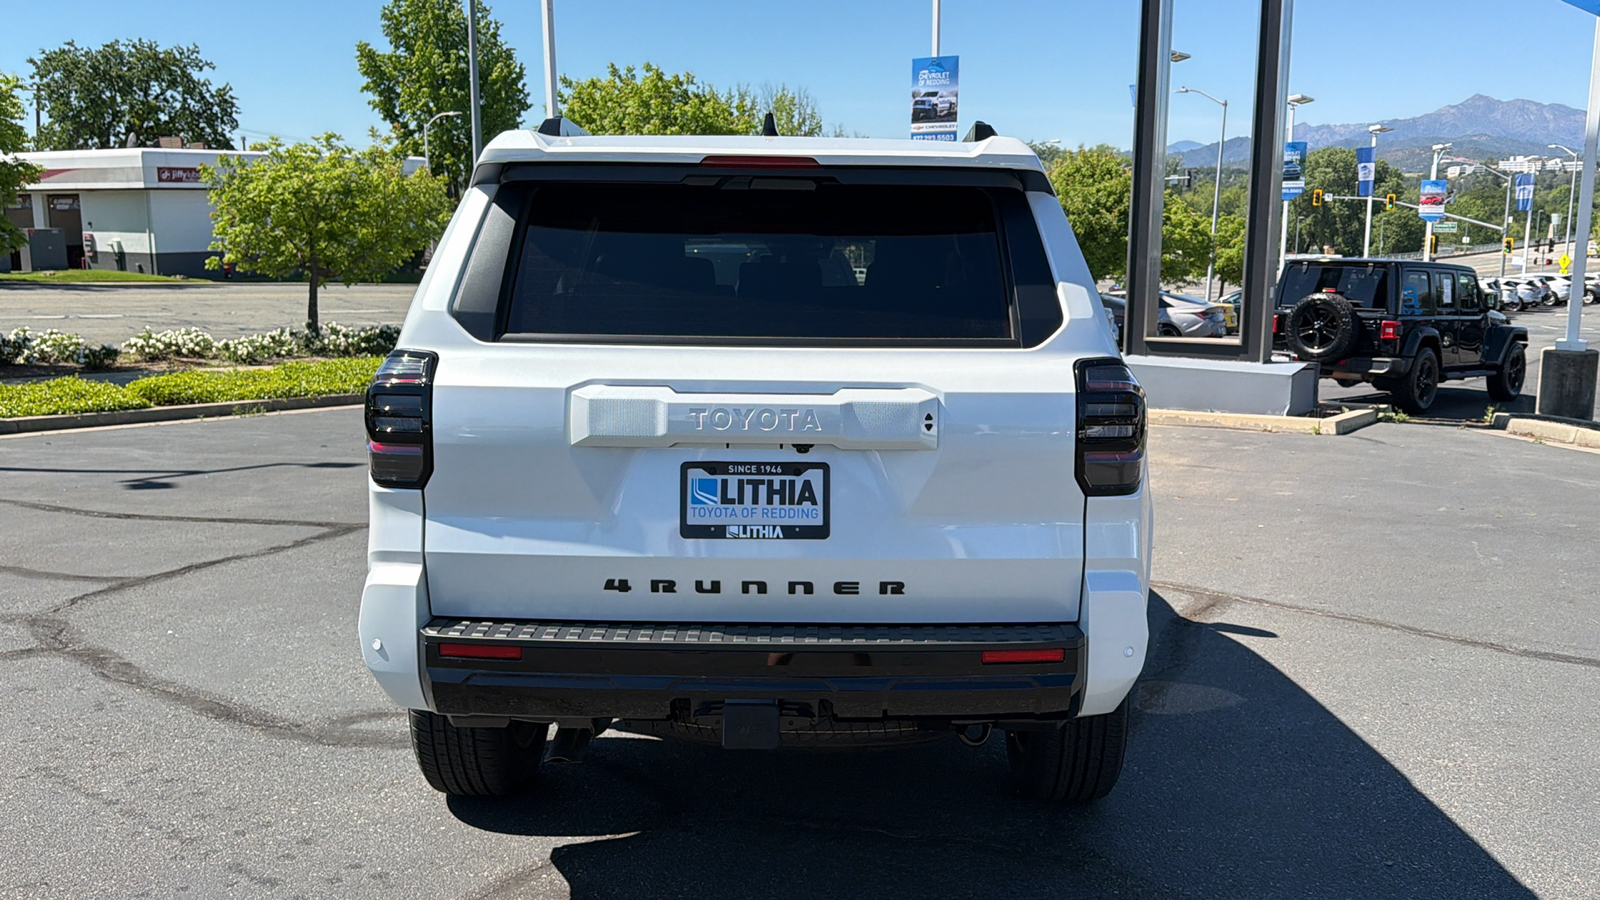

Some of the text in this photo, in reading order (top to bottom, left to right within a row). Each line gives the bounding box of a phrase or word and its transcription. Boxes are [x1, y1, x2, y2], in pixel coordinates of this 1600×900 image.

[918, 72, 950, 80] CHEVROLET
[689, 408, 822, 431] TOYOTA
[728, 465, 782, 474] SINCE 1946
[720, 478, 818, 506] LITHIA
[691, 507, 819, 519] TOYOTA OF REDDING
[739, 525, 784, 538] LITHIA
[603, 578, 905, 595] 4RUNNER
